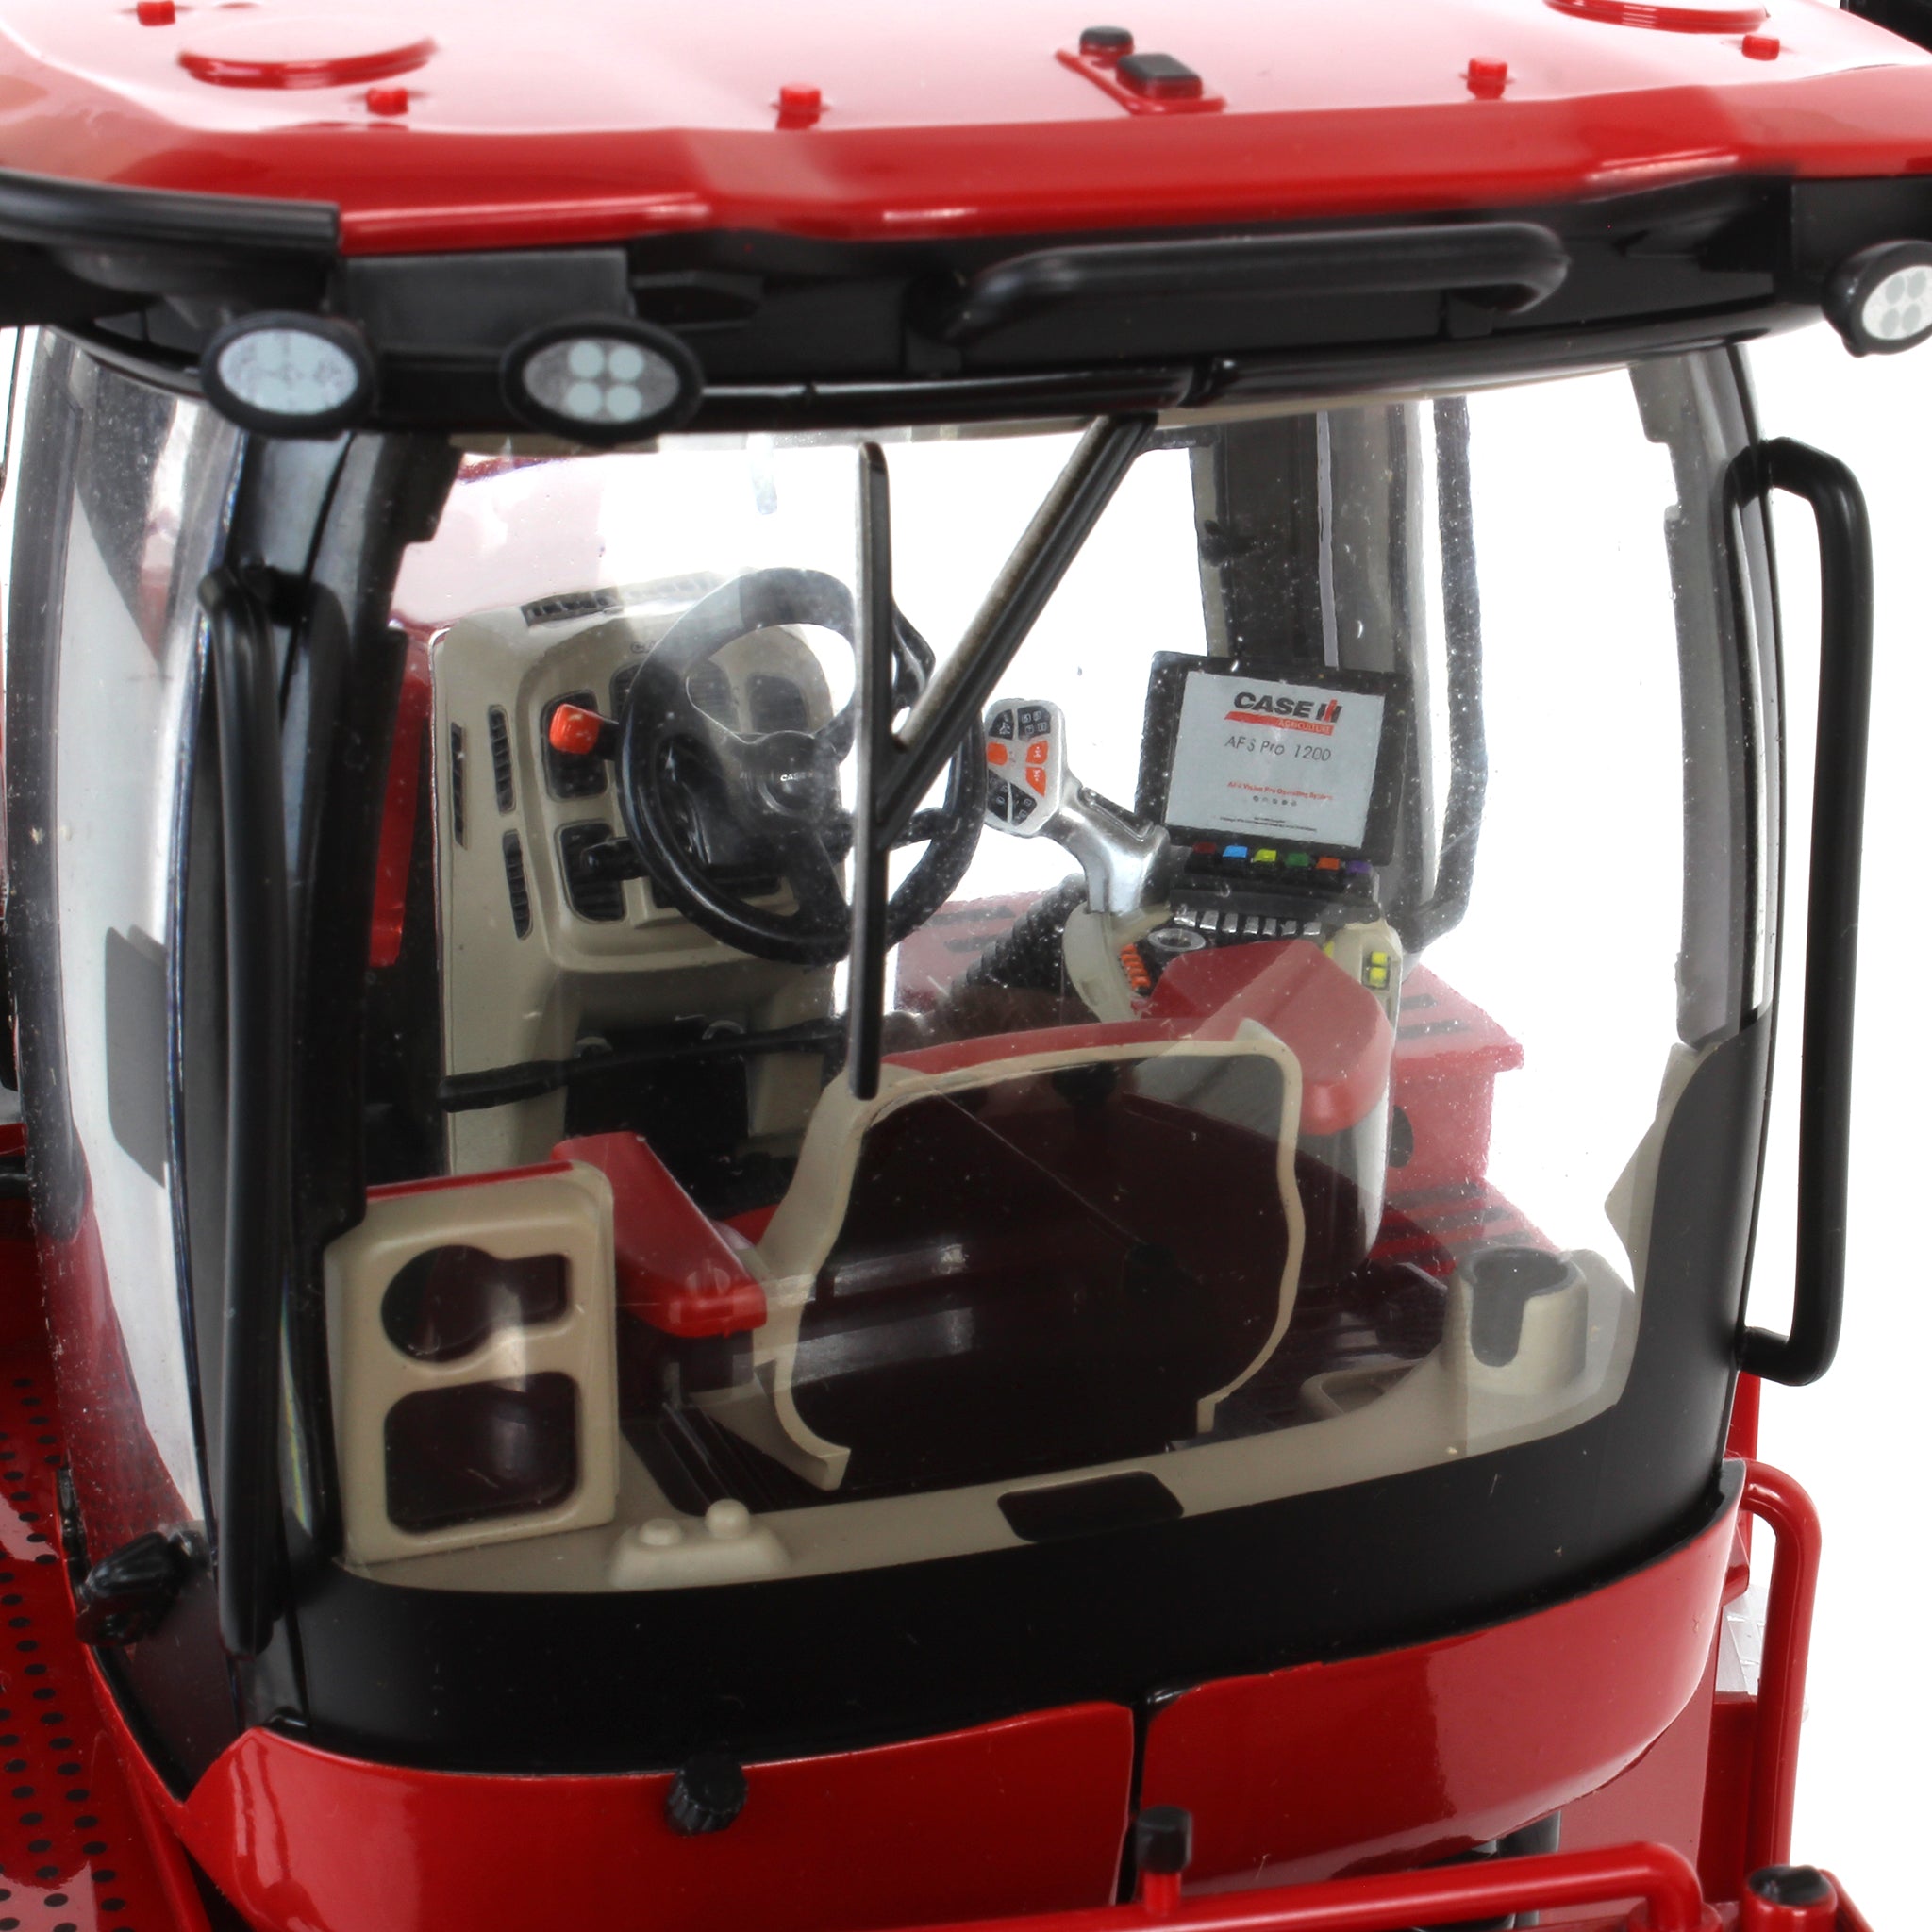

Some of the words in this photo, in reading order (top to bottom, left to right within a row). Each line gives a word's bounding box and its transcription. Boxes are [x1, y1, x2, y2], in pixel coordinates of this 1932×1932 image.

[1234, 691, 1314, 718] CASE
[1278, 720, 1331, 734] AGRICULTURE
[1224, 735, 1257, 753] AFS
[1260, 741, 1285, 756] Pro
[1294, 744, 1332, 761] 1200
